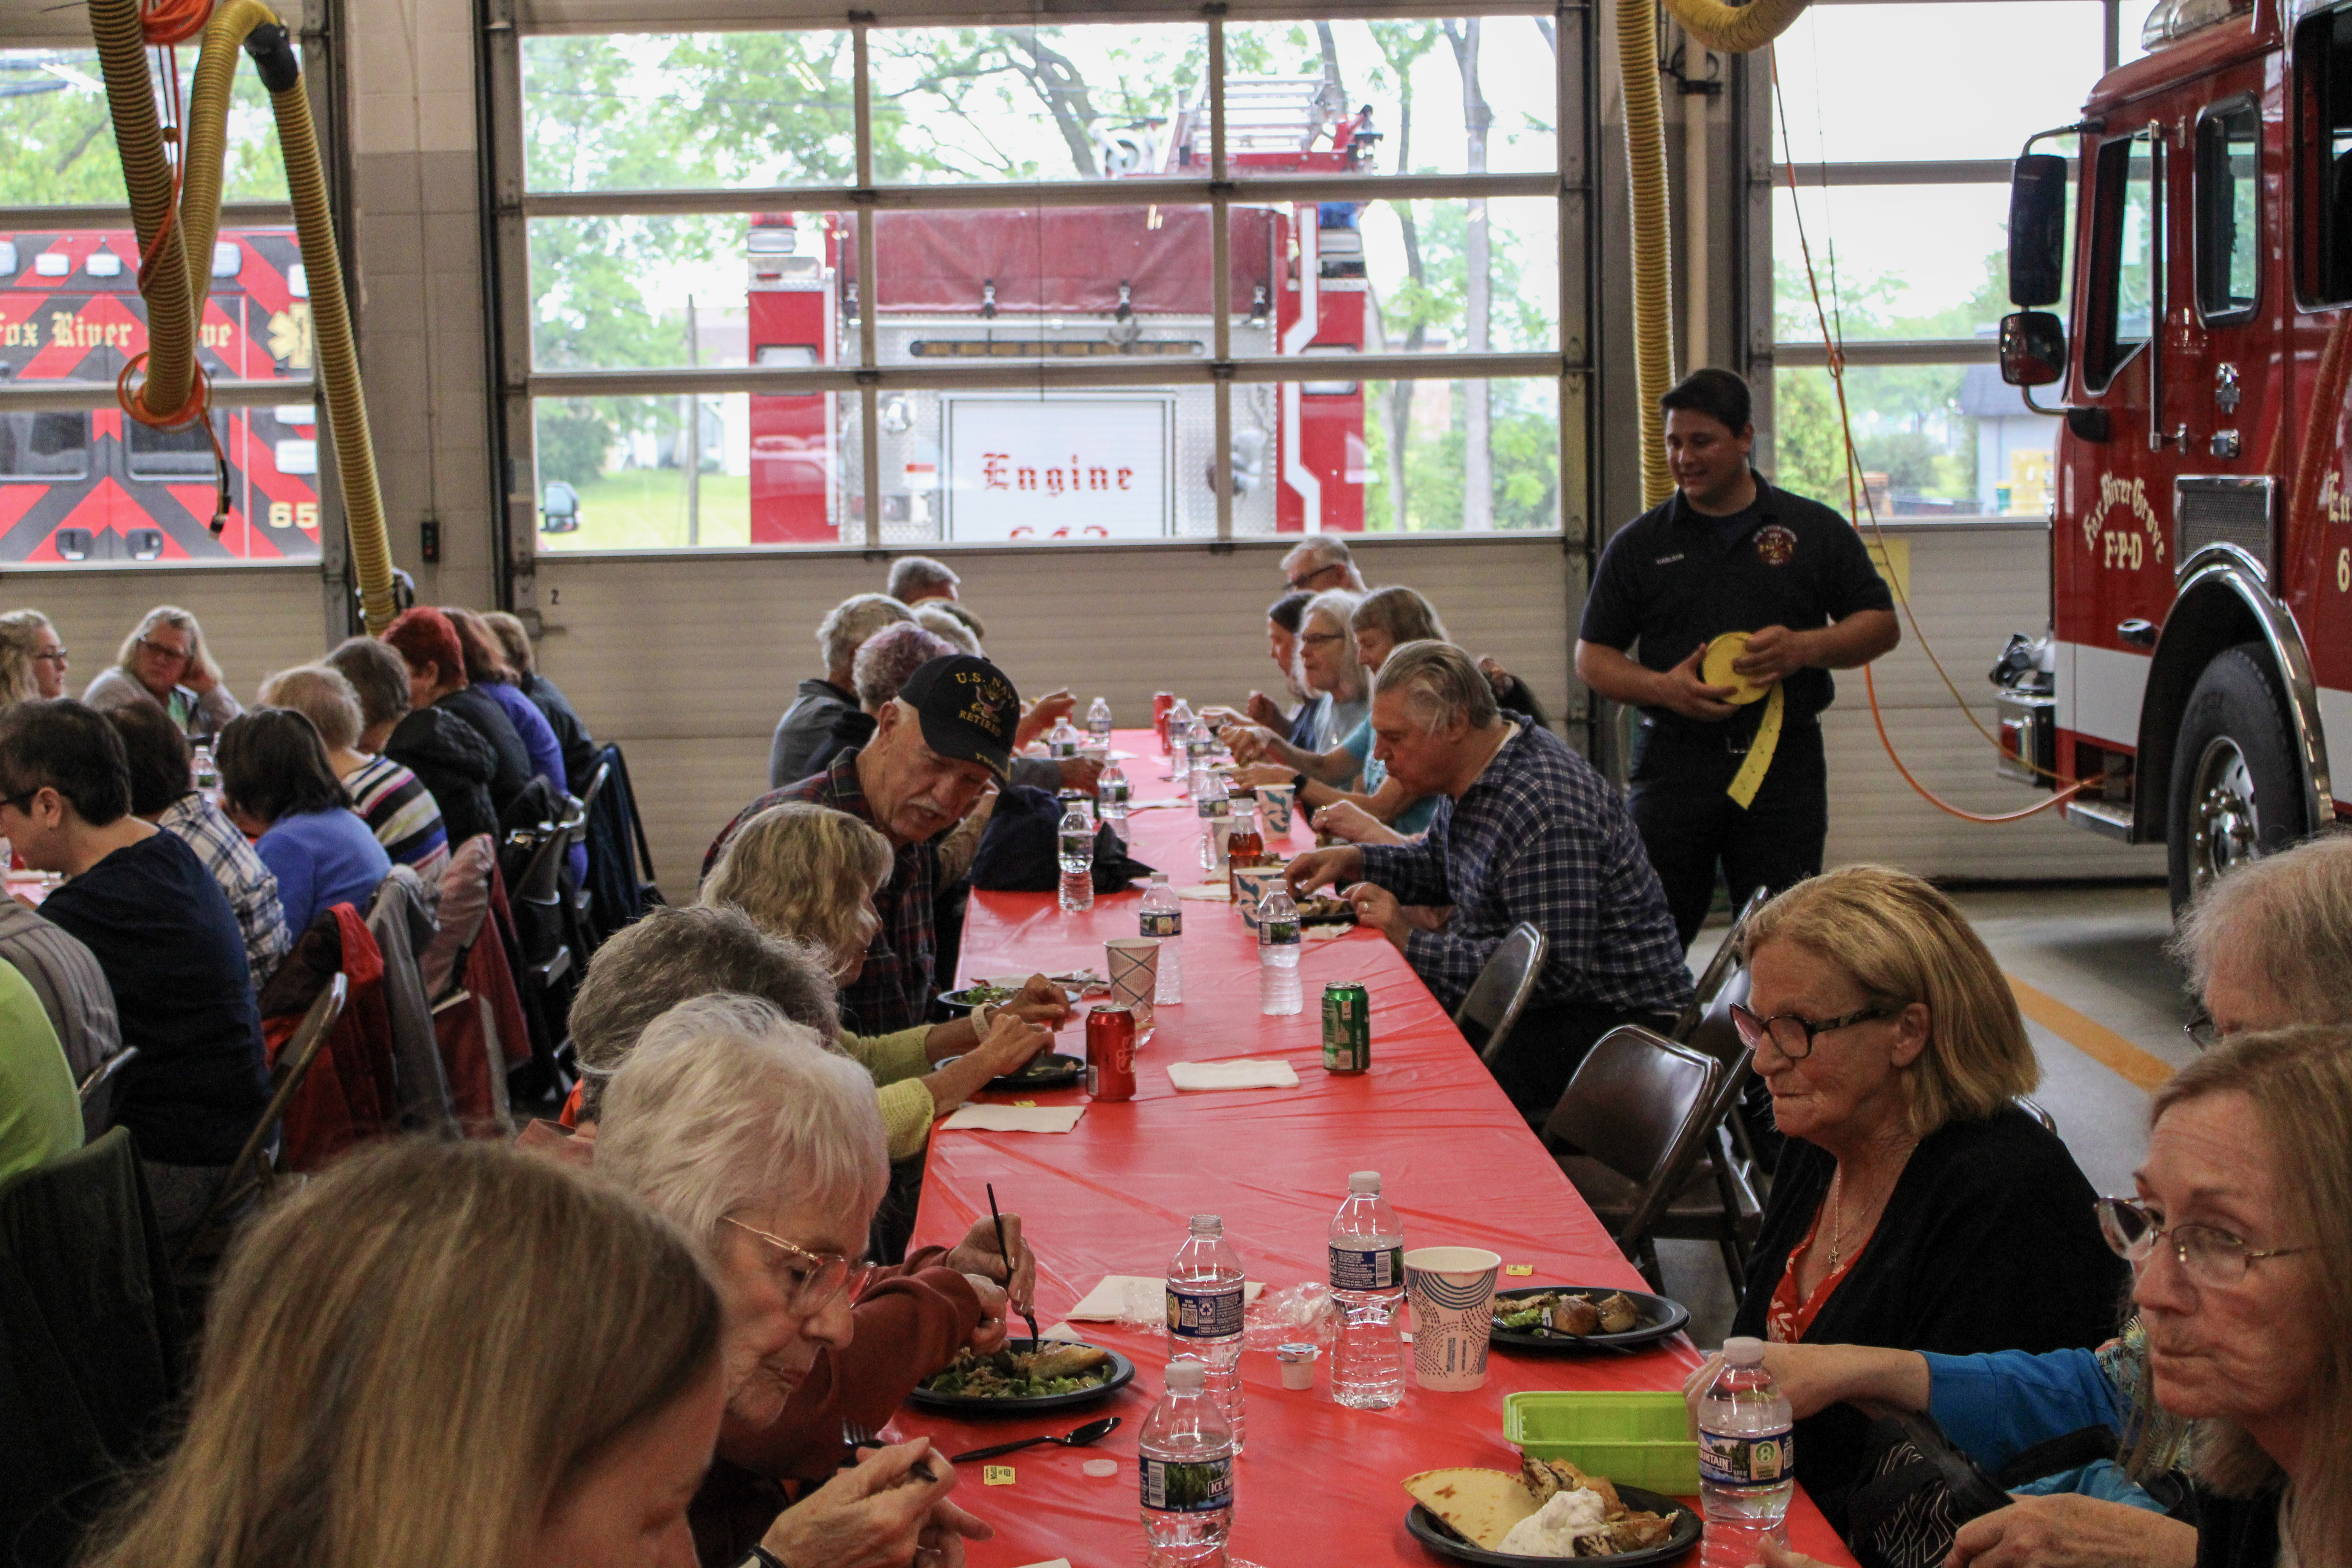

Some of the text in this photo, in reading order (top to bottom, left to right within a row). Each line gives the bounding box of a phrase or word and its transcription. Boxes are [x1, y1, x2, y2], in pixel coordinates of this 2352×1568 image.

[0, 311, 132, 347] ox River
[982, 453, 1134, 497] Engine
[269, 501, 319, 529] 65
[2082, 469, 2165, 564] Fox River Grove
[552, 589, 559, 604] 2
[956, 673, 985, 683] U.S.
[959, 710, 1001, 737] RETIRED
[1699, 1449, 1729, 1470] OUNTAIN
[1211, 1481, 1223, 1494] ICE
